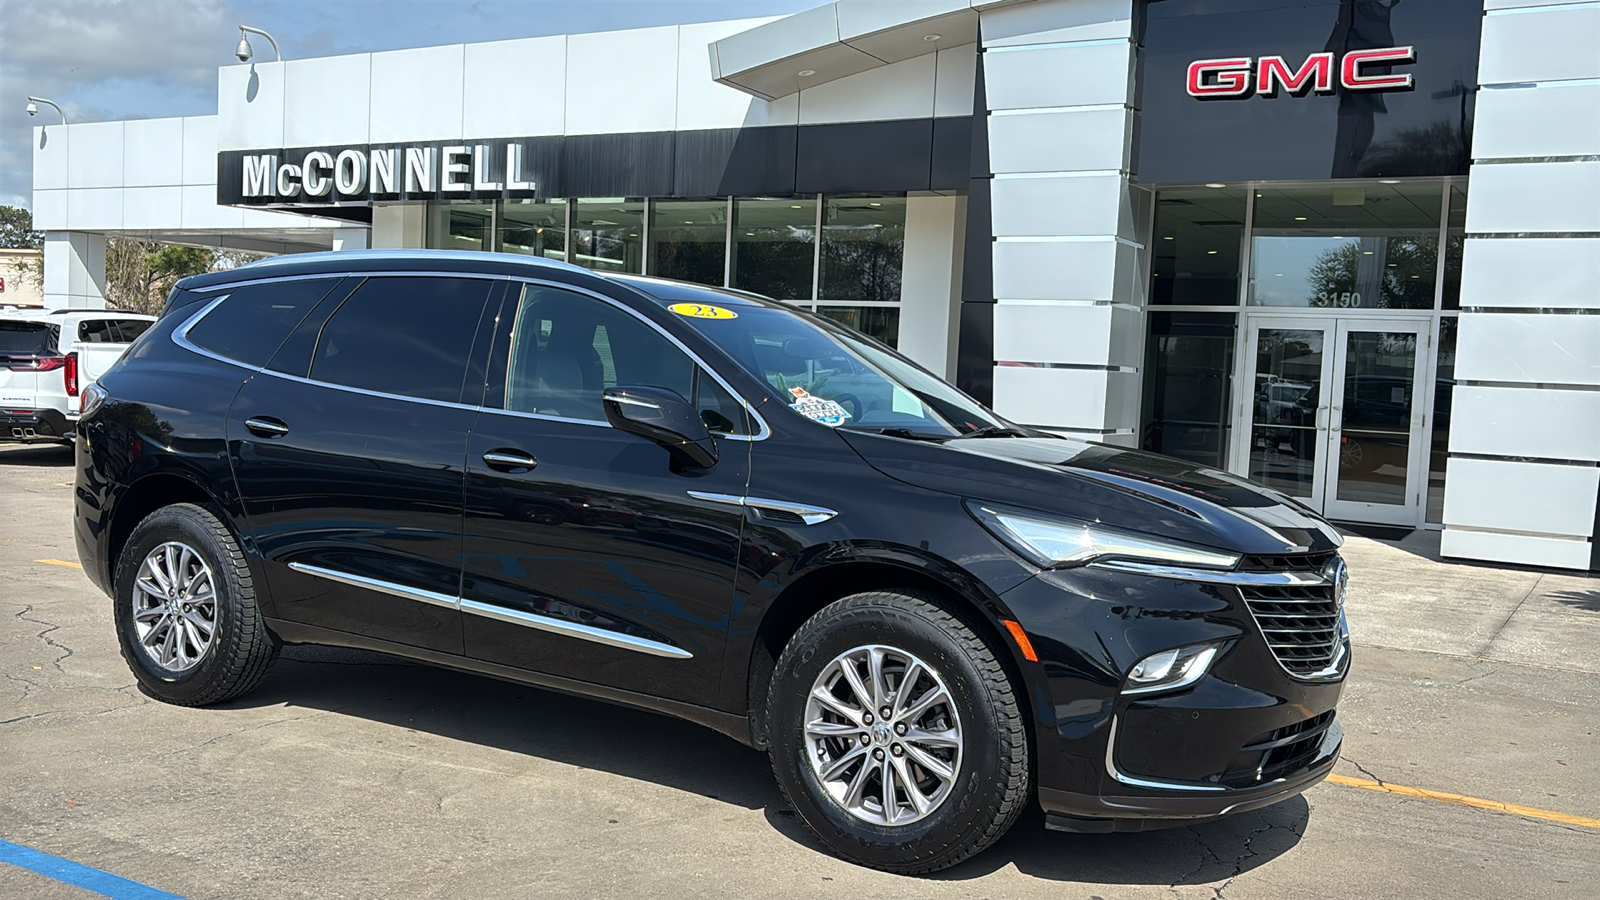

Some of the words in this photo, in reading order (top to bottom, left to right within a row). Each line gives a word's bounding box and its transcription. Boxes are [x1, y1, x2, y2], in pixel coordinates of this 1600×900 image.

[1187, 46, 1414, 98] GMC
[242, 143, 536, 197] McCONNELL
[689, 305, 718, 317] 23
[1317, 291, 1361, 308] 3150
